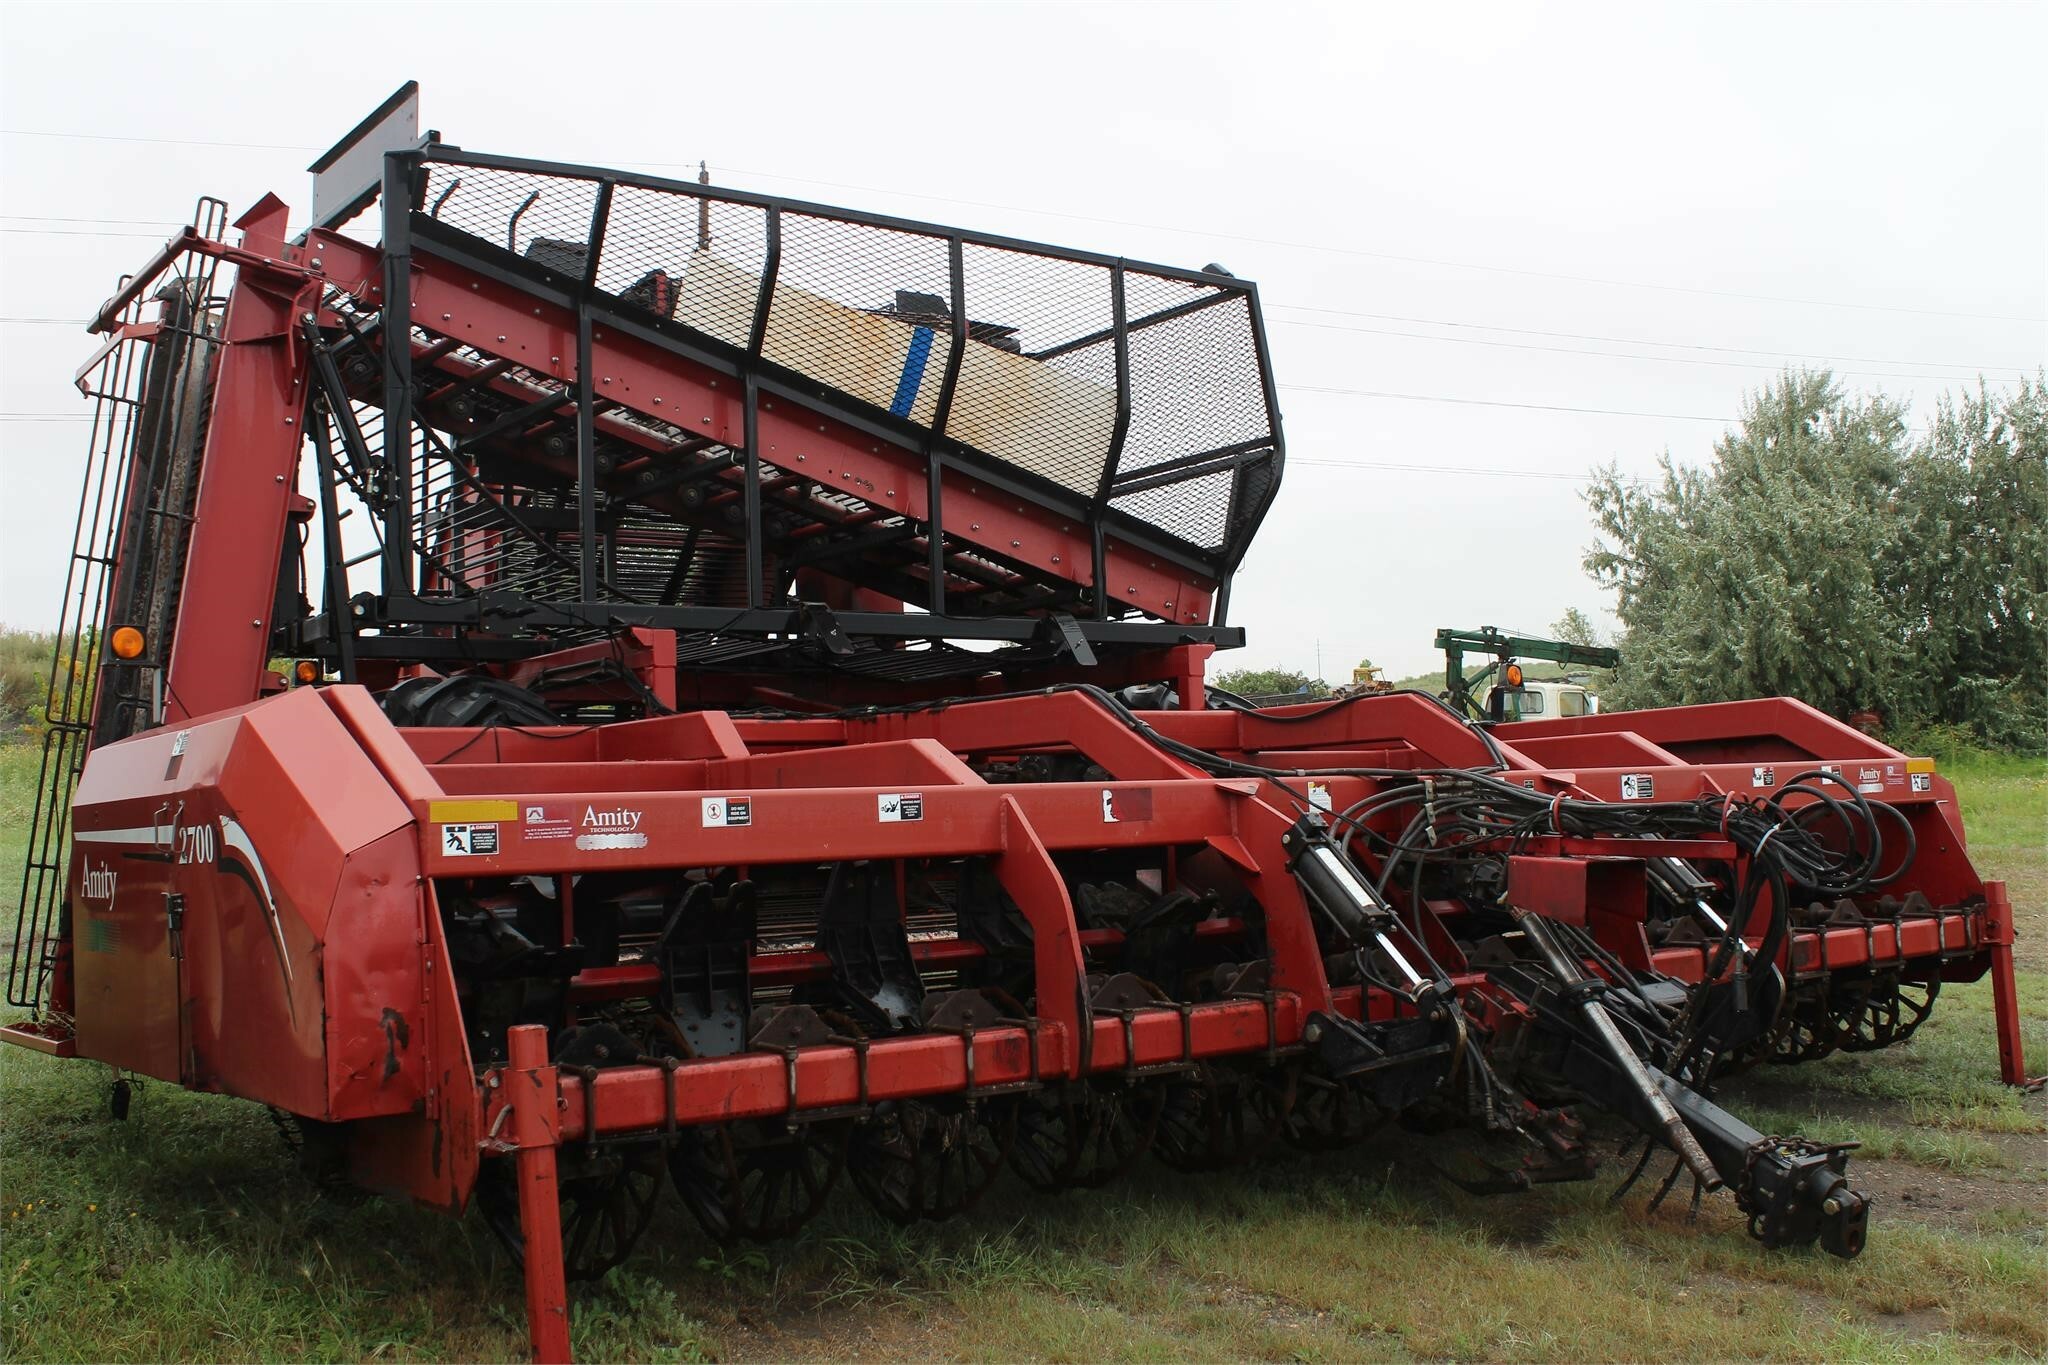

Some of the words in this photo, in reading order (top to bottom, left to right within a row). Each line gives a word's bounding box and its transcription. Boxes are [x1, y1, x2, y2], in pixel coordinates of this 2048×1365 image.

[1859, 767, 1881, 782] Amity
[582, 804, 642, 830] Amity
[178, 824, 214, 865] 2700
[81, 853, 117, 911] Amity
